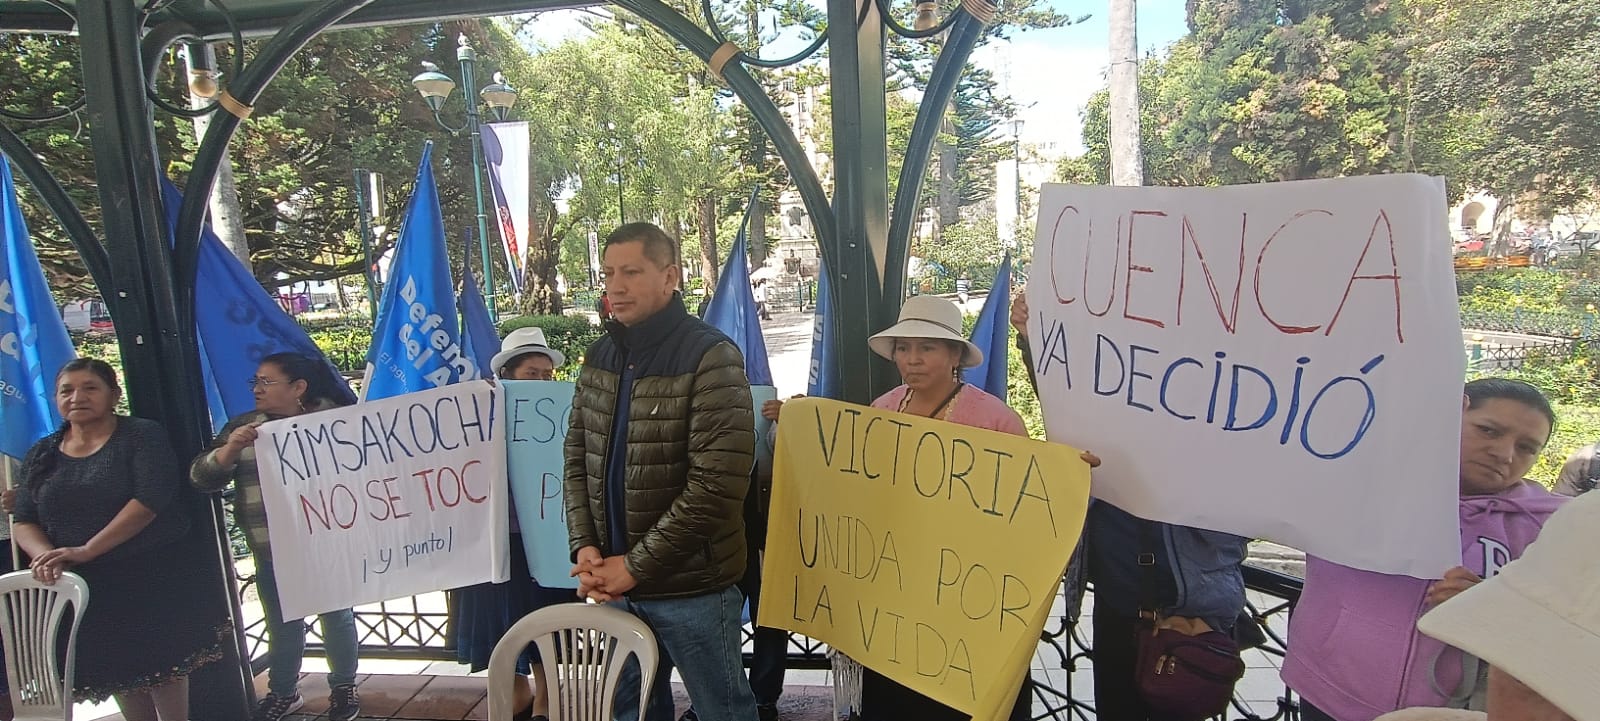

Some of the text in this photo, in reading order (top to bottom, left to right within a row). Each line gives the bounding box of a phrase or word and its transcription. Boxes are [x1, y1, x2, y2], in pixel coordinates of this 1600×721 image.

[1050, 205, 1404, 343] CUENCA
[1036, 311, 1072, 389] YA
[300, 460, 491, 535] NO SE TOC
[816, 406, 1058, 538] VICTORIA
[799, 508, 1032, 632] UNIDA POR
[793, 576, 976, 701] LA VIDA
